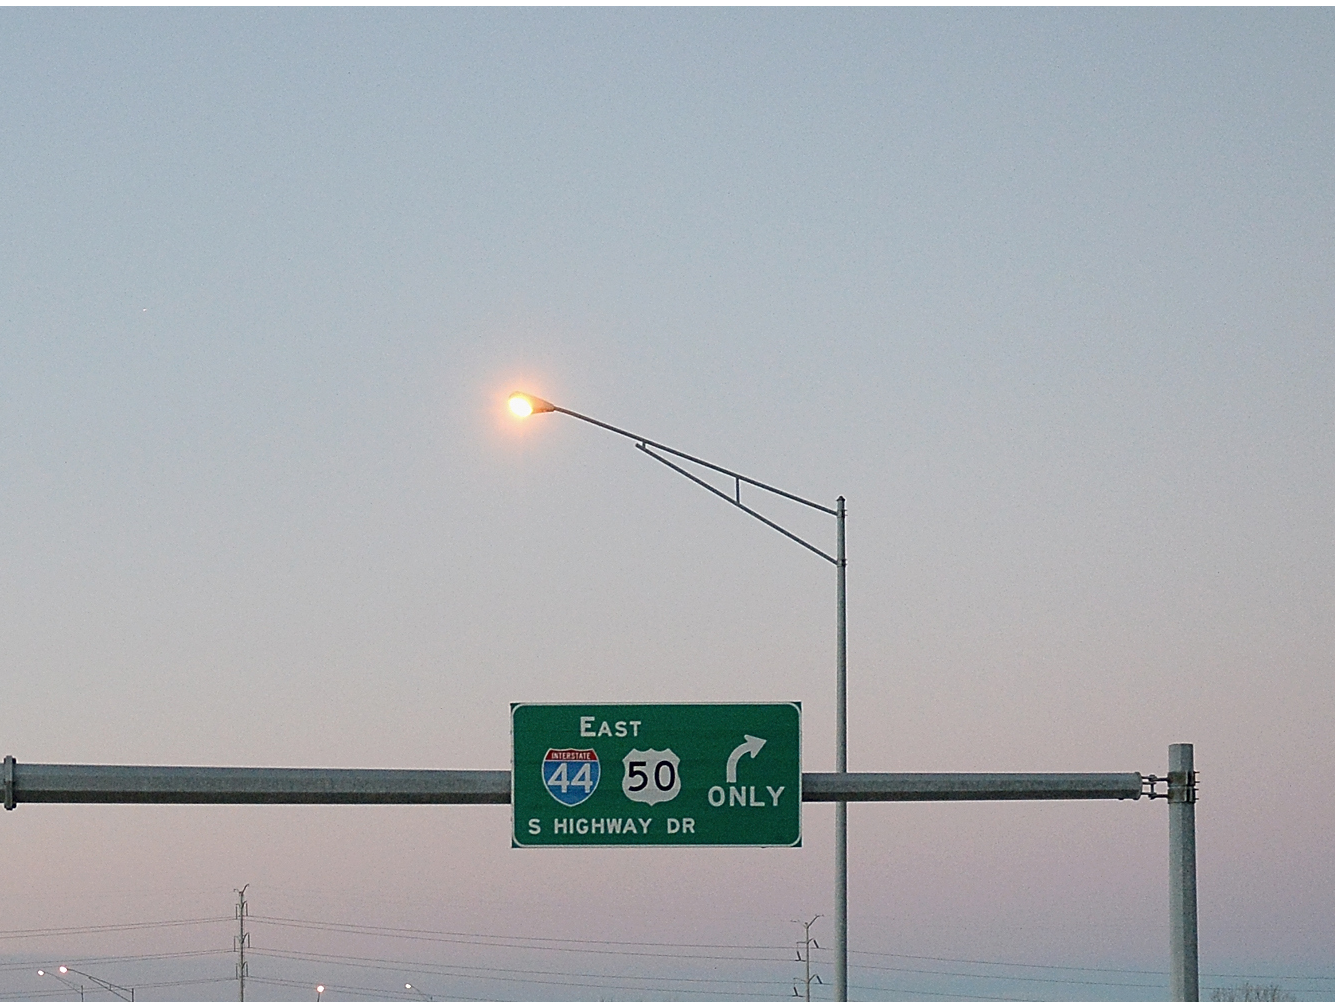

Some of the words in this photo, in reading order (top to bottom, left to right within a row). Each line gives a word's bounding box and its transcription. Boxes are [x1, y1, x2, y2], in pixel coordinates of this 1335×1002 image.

[551, 752, 591, 760] INTERSTATE
[547, 762, 593, 793] 44
[627, 761, 676, 792] 50
[707, 786, 785, 807] ONLY
[528, 819, 541, 835] S
[554, 818, 652, 834] HIGHWAY
[667, 818, 696, 834] DR
